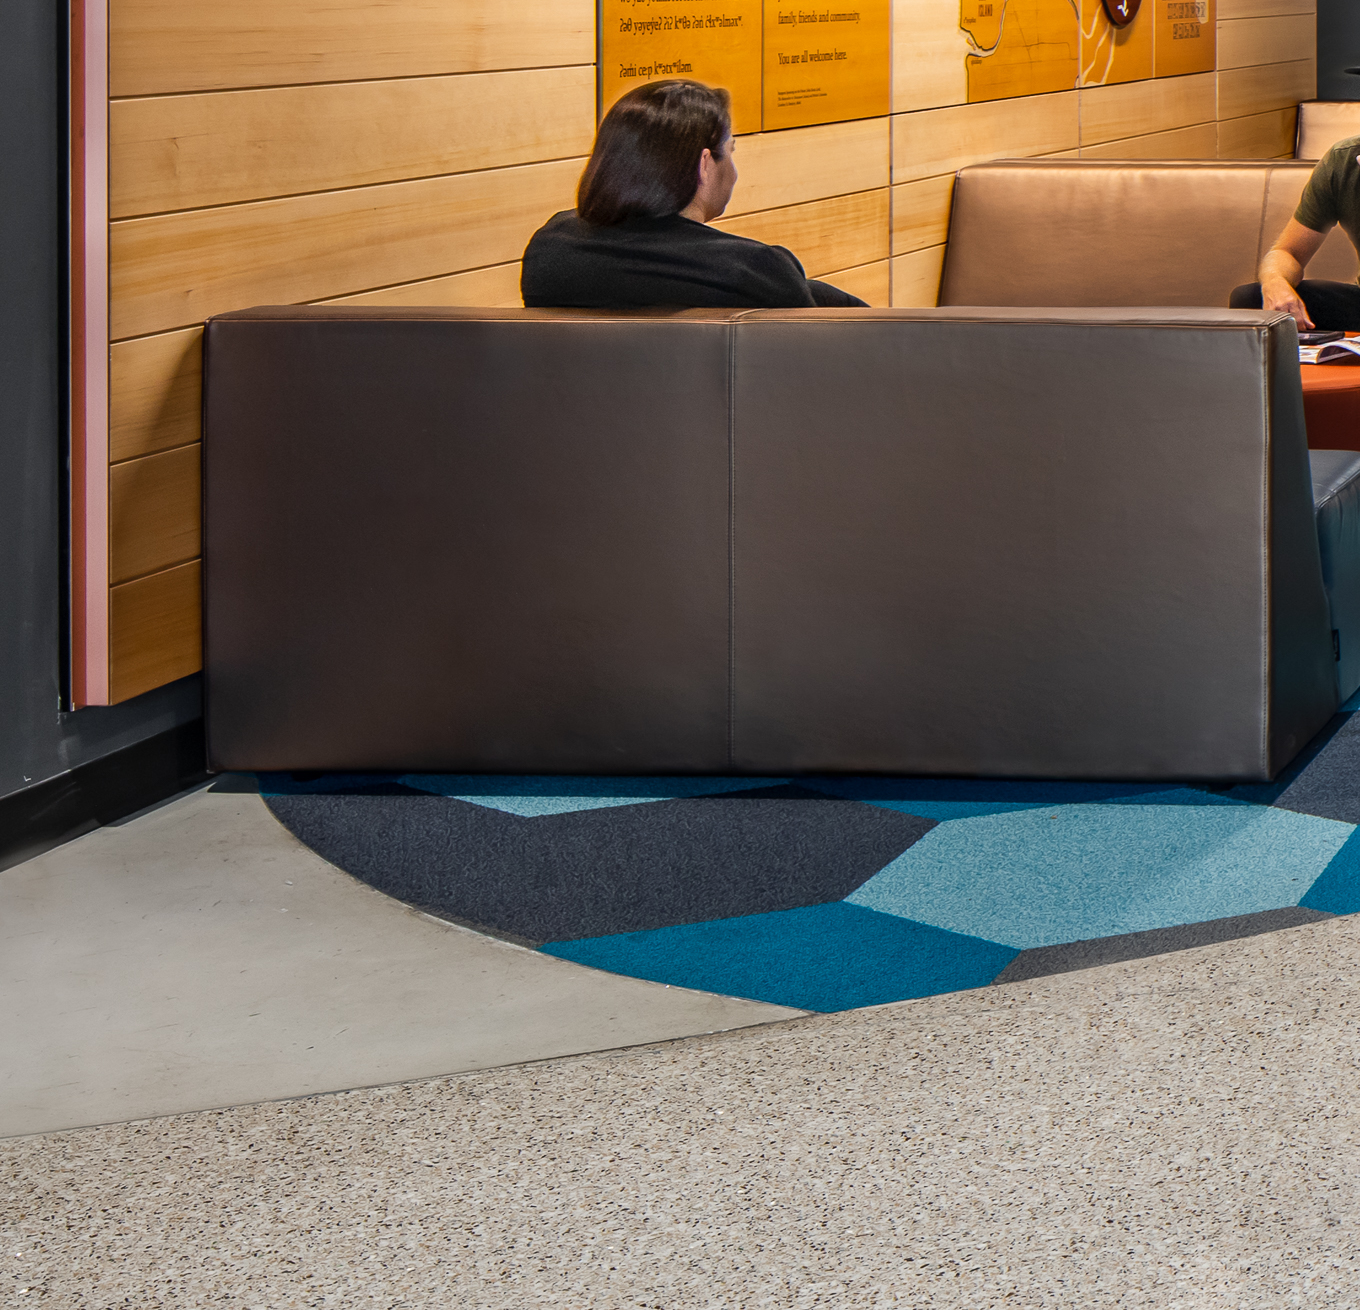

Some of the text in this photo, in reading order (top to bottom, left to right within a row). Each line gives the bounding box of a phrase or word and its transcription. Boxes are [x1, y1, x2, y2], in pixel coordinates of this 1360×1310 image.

[978, 4, 993, 17] ISLAND
[778, 53, 790, 65] You
[791, 55, 800, 64] are
[809, 50, 833, 62] welcome
[835, 49, 848, 61] here.
